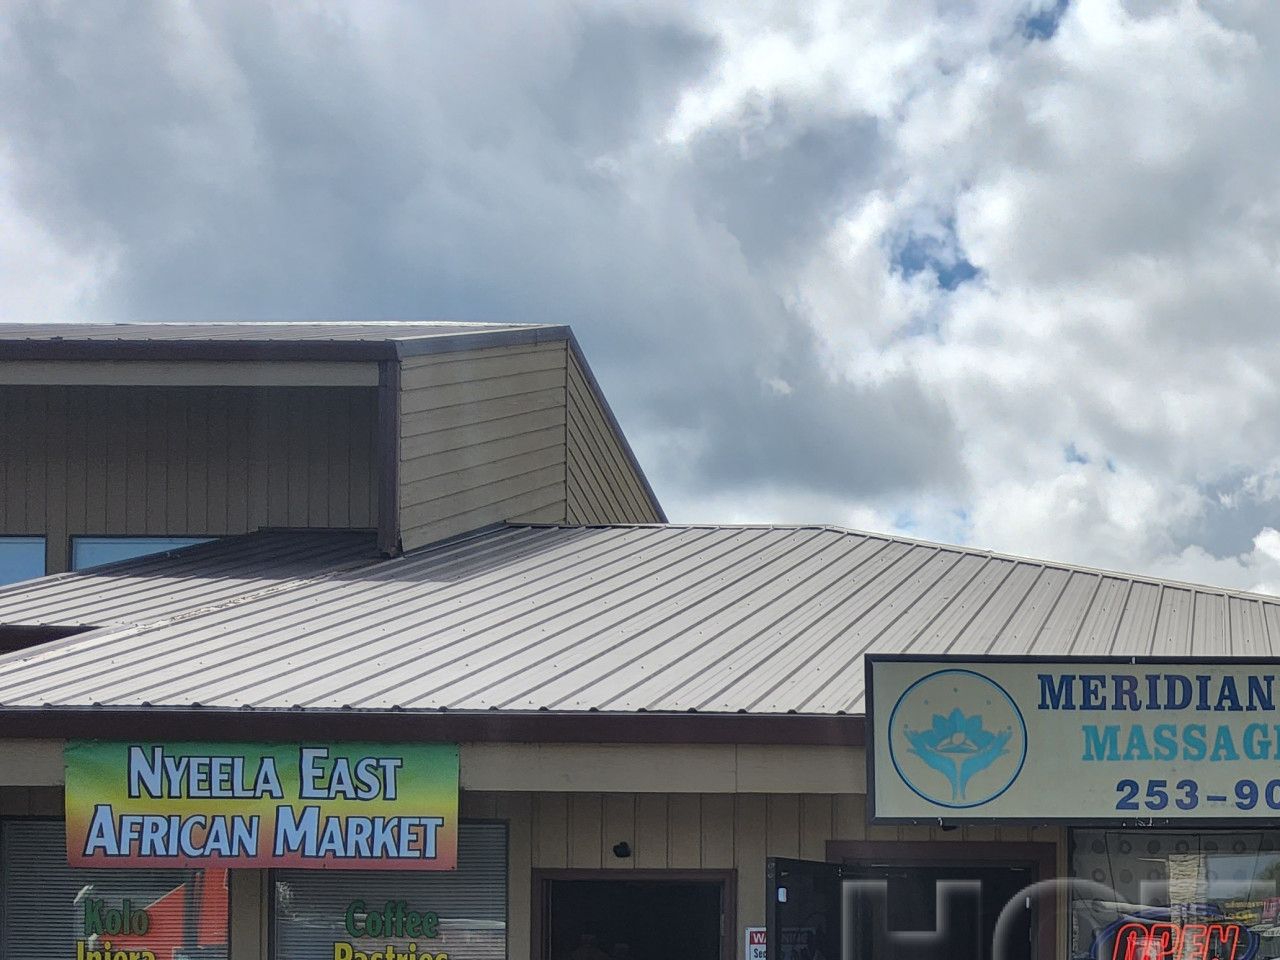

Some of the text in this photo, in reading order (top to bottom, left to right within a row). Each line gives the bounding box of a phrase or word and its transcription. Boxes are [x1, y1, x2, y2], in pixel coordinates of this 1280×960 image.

[1037, 674, 1275, 712] MERIDIAN
[127, 745, 403, 802] NYEELA EAST
[83, 803, 444, 860] AFRICAN MARKET
[83, 900, 149, 937] Kolo
[345, 901, 440, 939] Coffee
